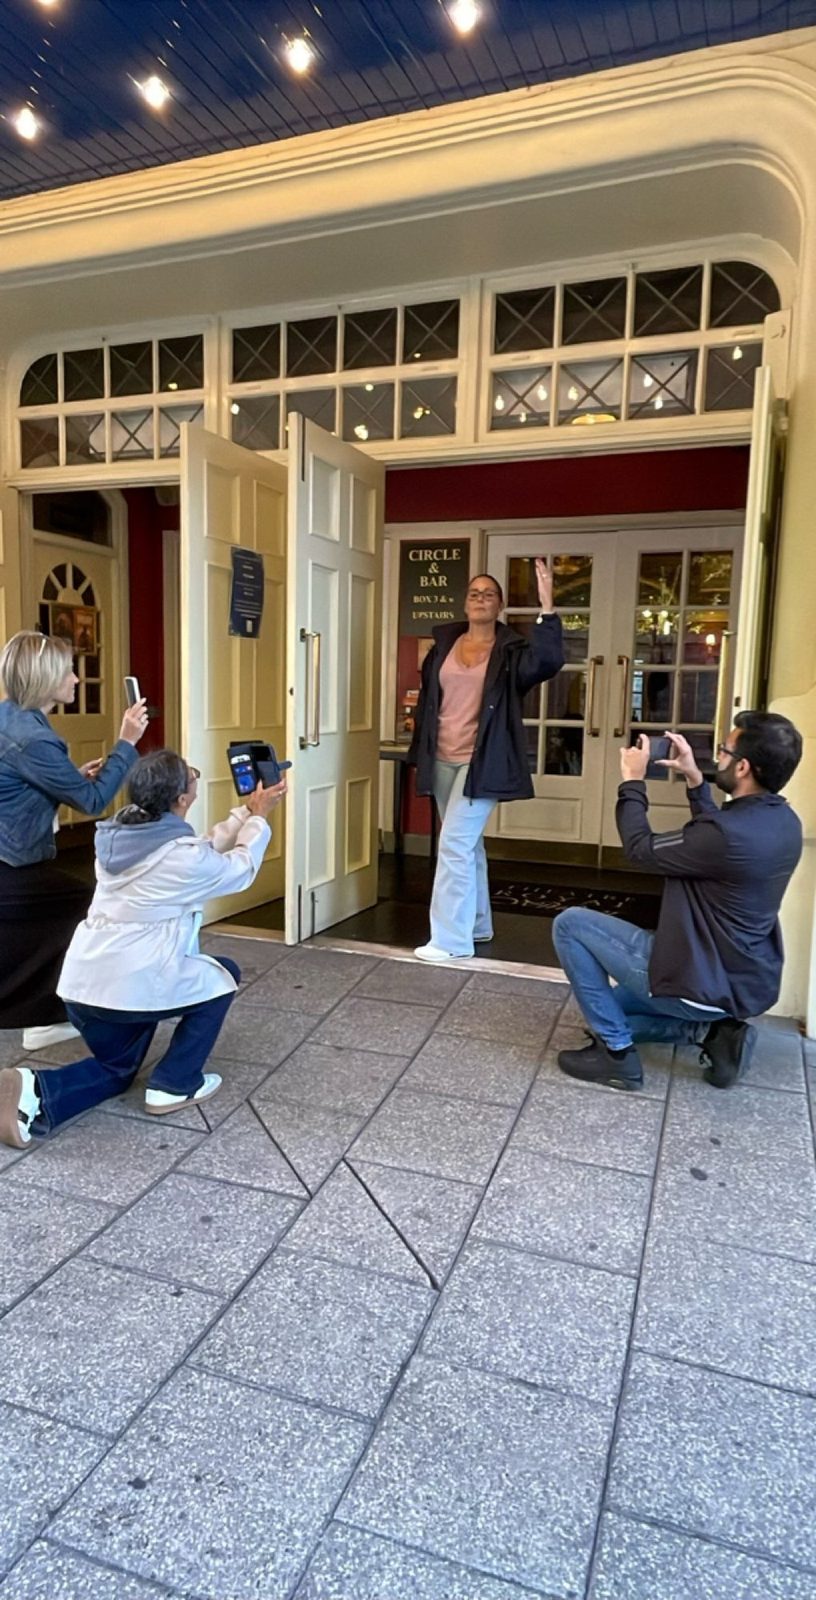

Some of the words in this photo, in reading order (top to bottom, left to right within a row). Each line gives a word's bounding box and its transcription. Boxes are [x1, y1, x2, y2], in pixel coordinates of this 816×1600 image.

[409, 549, 461, 561] CIRCLE
[428, 562, 439, 574] &
[420, 576, 448, 587] BAR
[413, 595, 432, 603] BOX
[412, 611, 455, 619] UPSTAIRS
